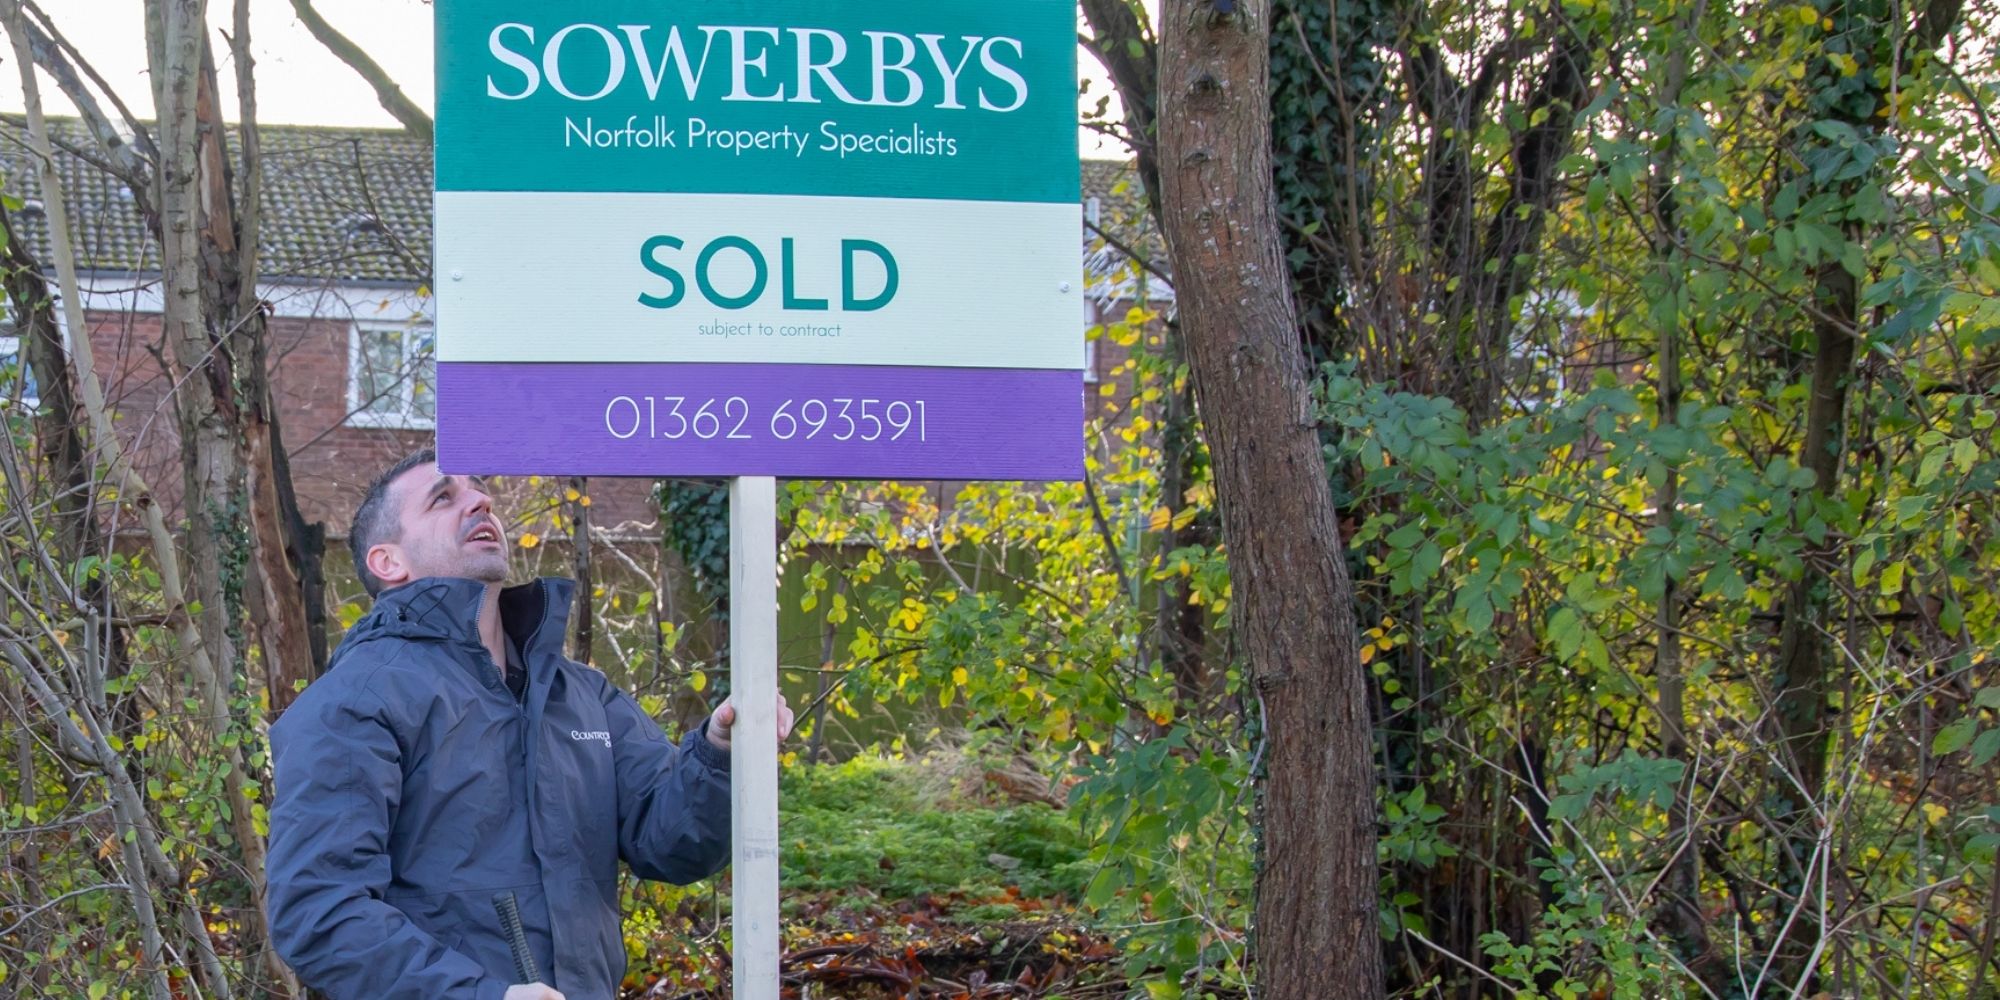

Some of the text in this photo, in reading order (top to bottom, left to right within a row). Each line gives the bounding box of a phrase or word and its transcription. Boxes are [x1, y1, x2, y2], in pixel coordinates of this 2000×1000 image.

[487, 22, 1028, 112] SOWERBYS
[565, 115, 957, 159] Norfolk Property Specialists
[638, 234, 899, 311] SOLD
[697, 318, 842, 339] subject to contract
[605, 395, 925, 442] 01362 693591
